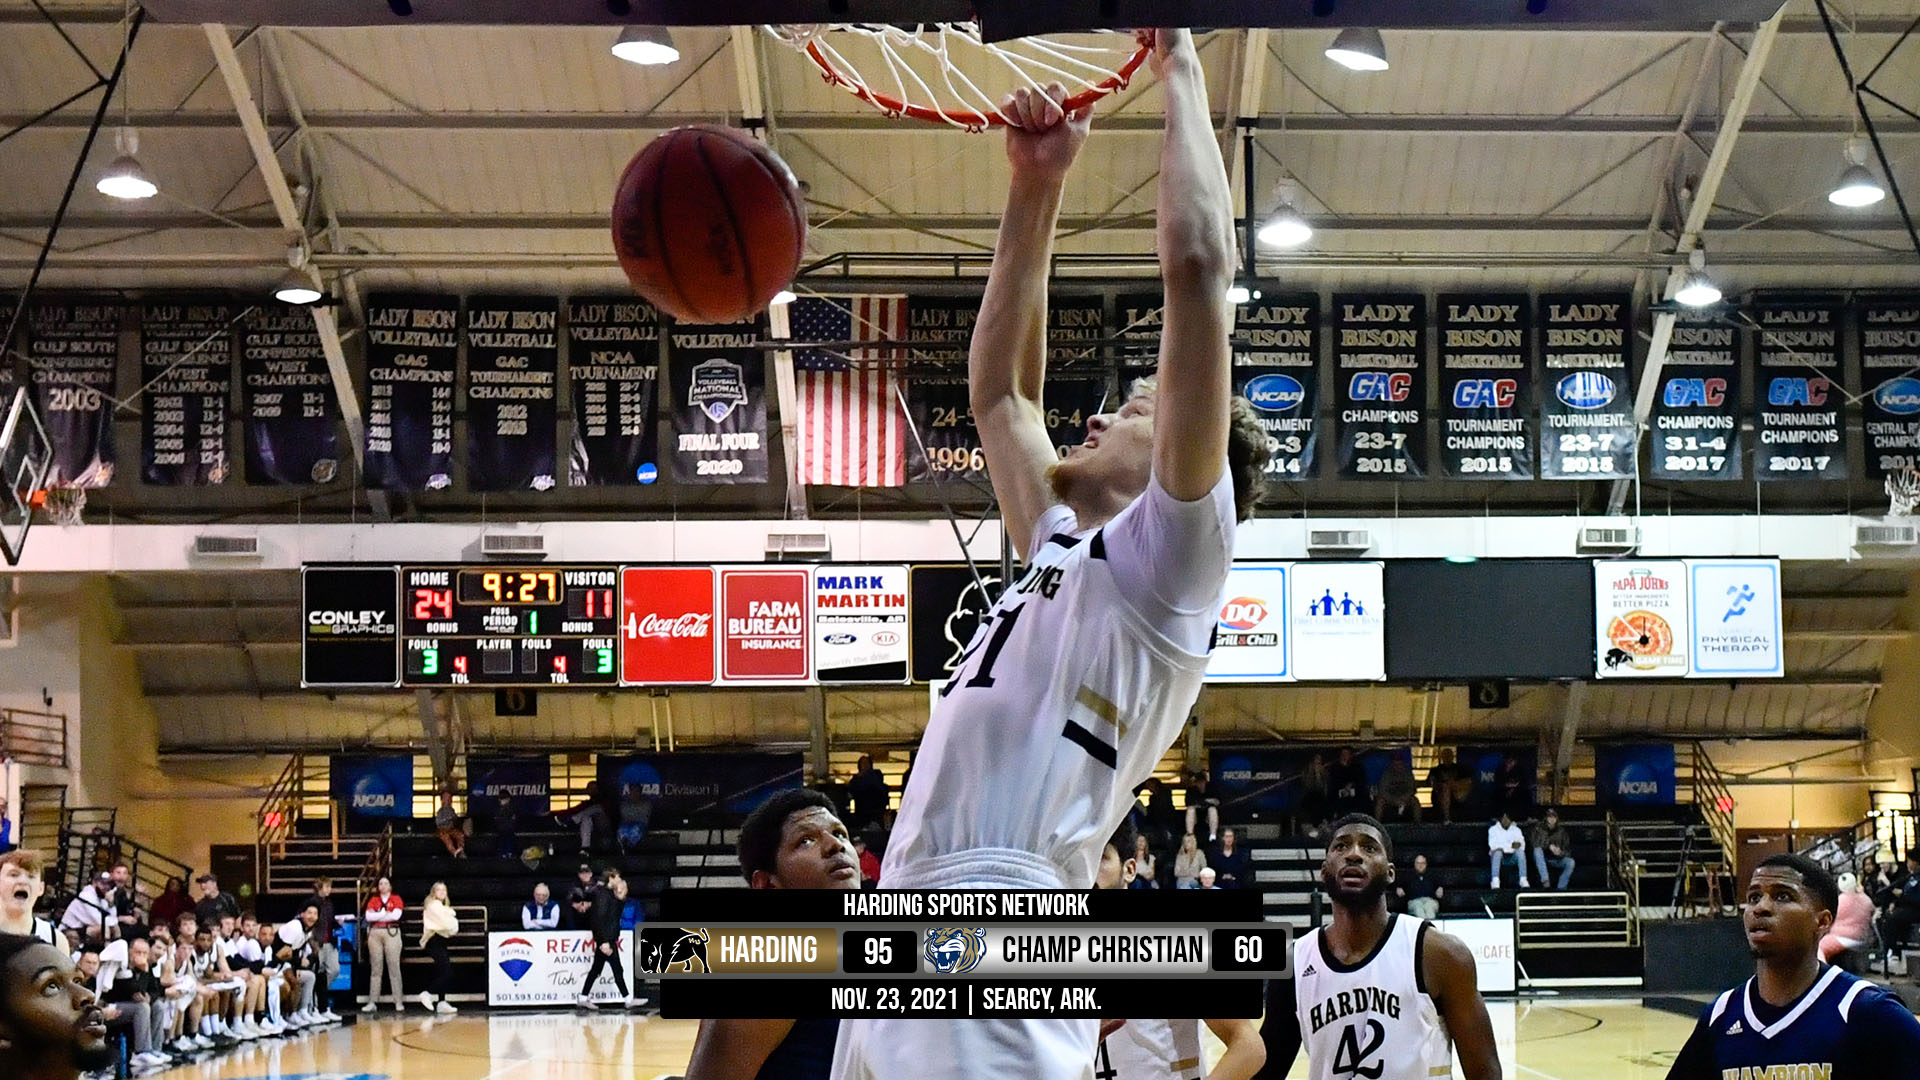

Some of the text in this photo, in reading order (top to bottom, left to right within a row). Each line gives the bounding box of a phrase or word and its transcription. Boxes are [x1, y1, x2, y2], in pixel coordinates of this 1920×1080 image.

[368, 308, 457, 329] LADY BISON
[468, 311, 556, 329] LADY BISON
[568, 304, 609, 323] LADY
[614, 304, 658, 323] BISON
[911, 309, 950, 327] LADY
[1059, 309, 1102, 326] BISON
[1237, 306, 1311, 324] LADY
[1343, 305, 1415, 322] LADY
[1448, 305, 1520, 322] LADY
[1549, 305, 1620, 322] LADY
[1763, 310, 1829, 323] LADY
[368, 330, 457, 347] VOLLEYBALL
[468, 333, 556, 348] VOLLEYBALL
[570, 327, 658, 341] VOLLEYBALL
[672, 334, 757, 349] VOLLEYBALL
[1235, 329, 1312, 347] BISON
[1340, 329, 1417, 347] BISON
[1445, 329, 1523, 347] BISON
[1546, 329, 1624, 347] BISON
[1671, 328, 1733, 346] ISON
[1761, 330, 1835, 346] BISON
[394, 353, 428, 367] GAC
[495, 356, 529, 368] GAC
[590, 351, 635, 365] NCAA
[1234, 352, 1313, 367] BASKETBALL
[1339, 354, 1418, 368] BASKETBALL
[1445, 354, 1524, 369] BASKETBALL
[1546, 354, 1625, 368] BASKETBALL
[1760, 352, 1837, 367] BASKETBALL
[369, 368, 454, 383] CHAMPIONS
[470, 371, 554, 383] TOURNAMENT
[569, 366, 658, 380] TOURNAMENT
[469, 386, 554, 399] CHAMPIONS
[693, 385, 741, 394] NATIONAL
[1348, 372, 1412, 401] GAC
[1453, 379, 1517, 408] GAC
[1663, 378, 1727, 407] GAC
[1768, 377, 1830, 406] GAC
[48, 388, 101, 411] 2003
[1250, 391, 1302, 402] NCAA
[1342, 410, 1419, 423] CHAMPIONS
[1548, 413, 1625, 427] TOURNAMENT
[1657, 415, 1734, 429] CHAMPIONS
[1761, 411, 1837, 426] TOURNAMENT
[1446, 418, 1524, 432] TOURNAMENT
[1866, 422, 1906, 435] CENTRAL
[678, 433, 760, 451] FINAL FOUR
[1354, 432, 1407, 449] 23-7
[1446, 436, 1525, 450] CHAMPIONS
[1559, 434, 1615, 452] 23-7
[1664, 436, 1727, 451] 31-4
[1760, 429, 1840, 443] CHAMPIONS
[926, 446, 985, 472] 1996
[1356, 458, 1407, 473] 2015
[1460, 457, 1512, 473] 2015
[1561, 457, 1614, 473] 2015
[1664, 456, 1726, 471] 2017
[1769, 456, 1831, 471] 2017
[696, 460, 743, 475] 2020
[410, 572, 449, 586] HOME
[564, 571, 616, 586] VISITOR
[817, 576, 884, 589] MARK
[1612, 575, 1669, 590] PAPA JOHNS
[482, 572, 557, 602] 9:27
[415, 589, 453, 619] 24
[586, 589, 613, 619] 11
[817, 594, 905, 608] MARTIN
[490, 607, 510, 615] POSS
[749, 601, 801, 617] FARM
[1225, 603, 1263, 624] DQ
[308, 610, 386, 624] CONLEY
[483, 616, 518, 626] PERIOD
[529, 610, 538, 635] 1
[818, 615, 905, 623] Batesville, AR
[331, 624, 395, 634] GRAPHICS
[426, 622, 459, 633] BONUS
[561, 622, 594, 633] BONUS
[638, 612, 712, 638] Coca-Cola
[728, 618, 802, 634] BUREAU
[408, 639, 439, 650] FOULS
[476, 639, 512, 650] PLAYER
[521, 639, 552, 649] FOULS
[582, 639, 613, 649] FOULS
[741, 639, 802, 650] INSURANCE
[828, 633, 896, 645] Ford KIA
[422, 649, 438, 674] 3
[453, 656, 467, 674] 4
[553, 655, 567, 673] 4
[596, 648, 613, 674] 3
[450, 673, 470, 684] TOL
[550, 673, 569, 684] TOL
[486, 783, 547, 797] BASKETBALL
[664, 783, 710, 796] Division
[1618, 781, 1658, 794] NCAA
[352, 793, 395, 808] NCAA
[546, 938, 624, 953] RE/MX
[1483, 944, 1512, 959] CAFE
[1309, 986, 1401, 1035] HARDNG
[1332, 1018, 1386, 1080] 42
[1721, 1062, 1834, 1080] HAMPION
